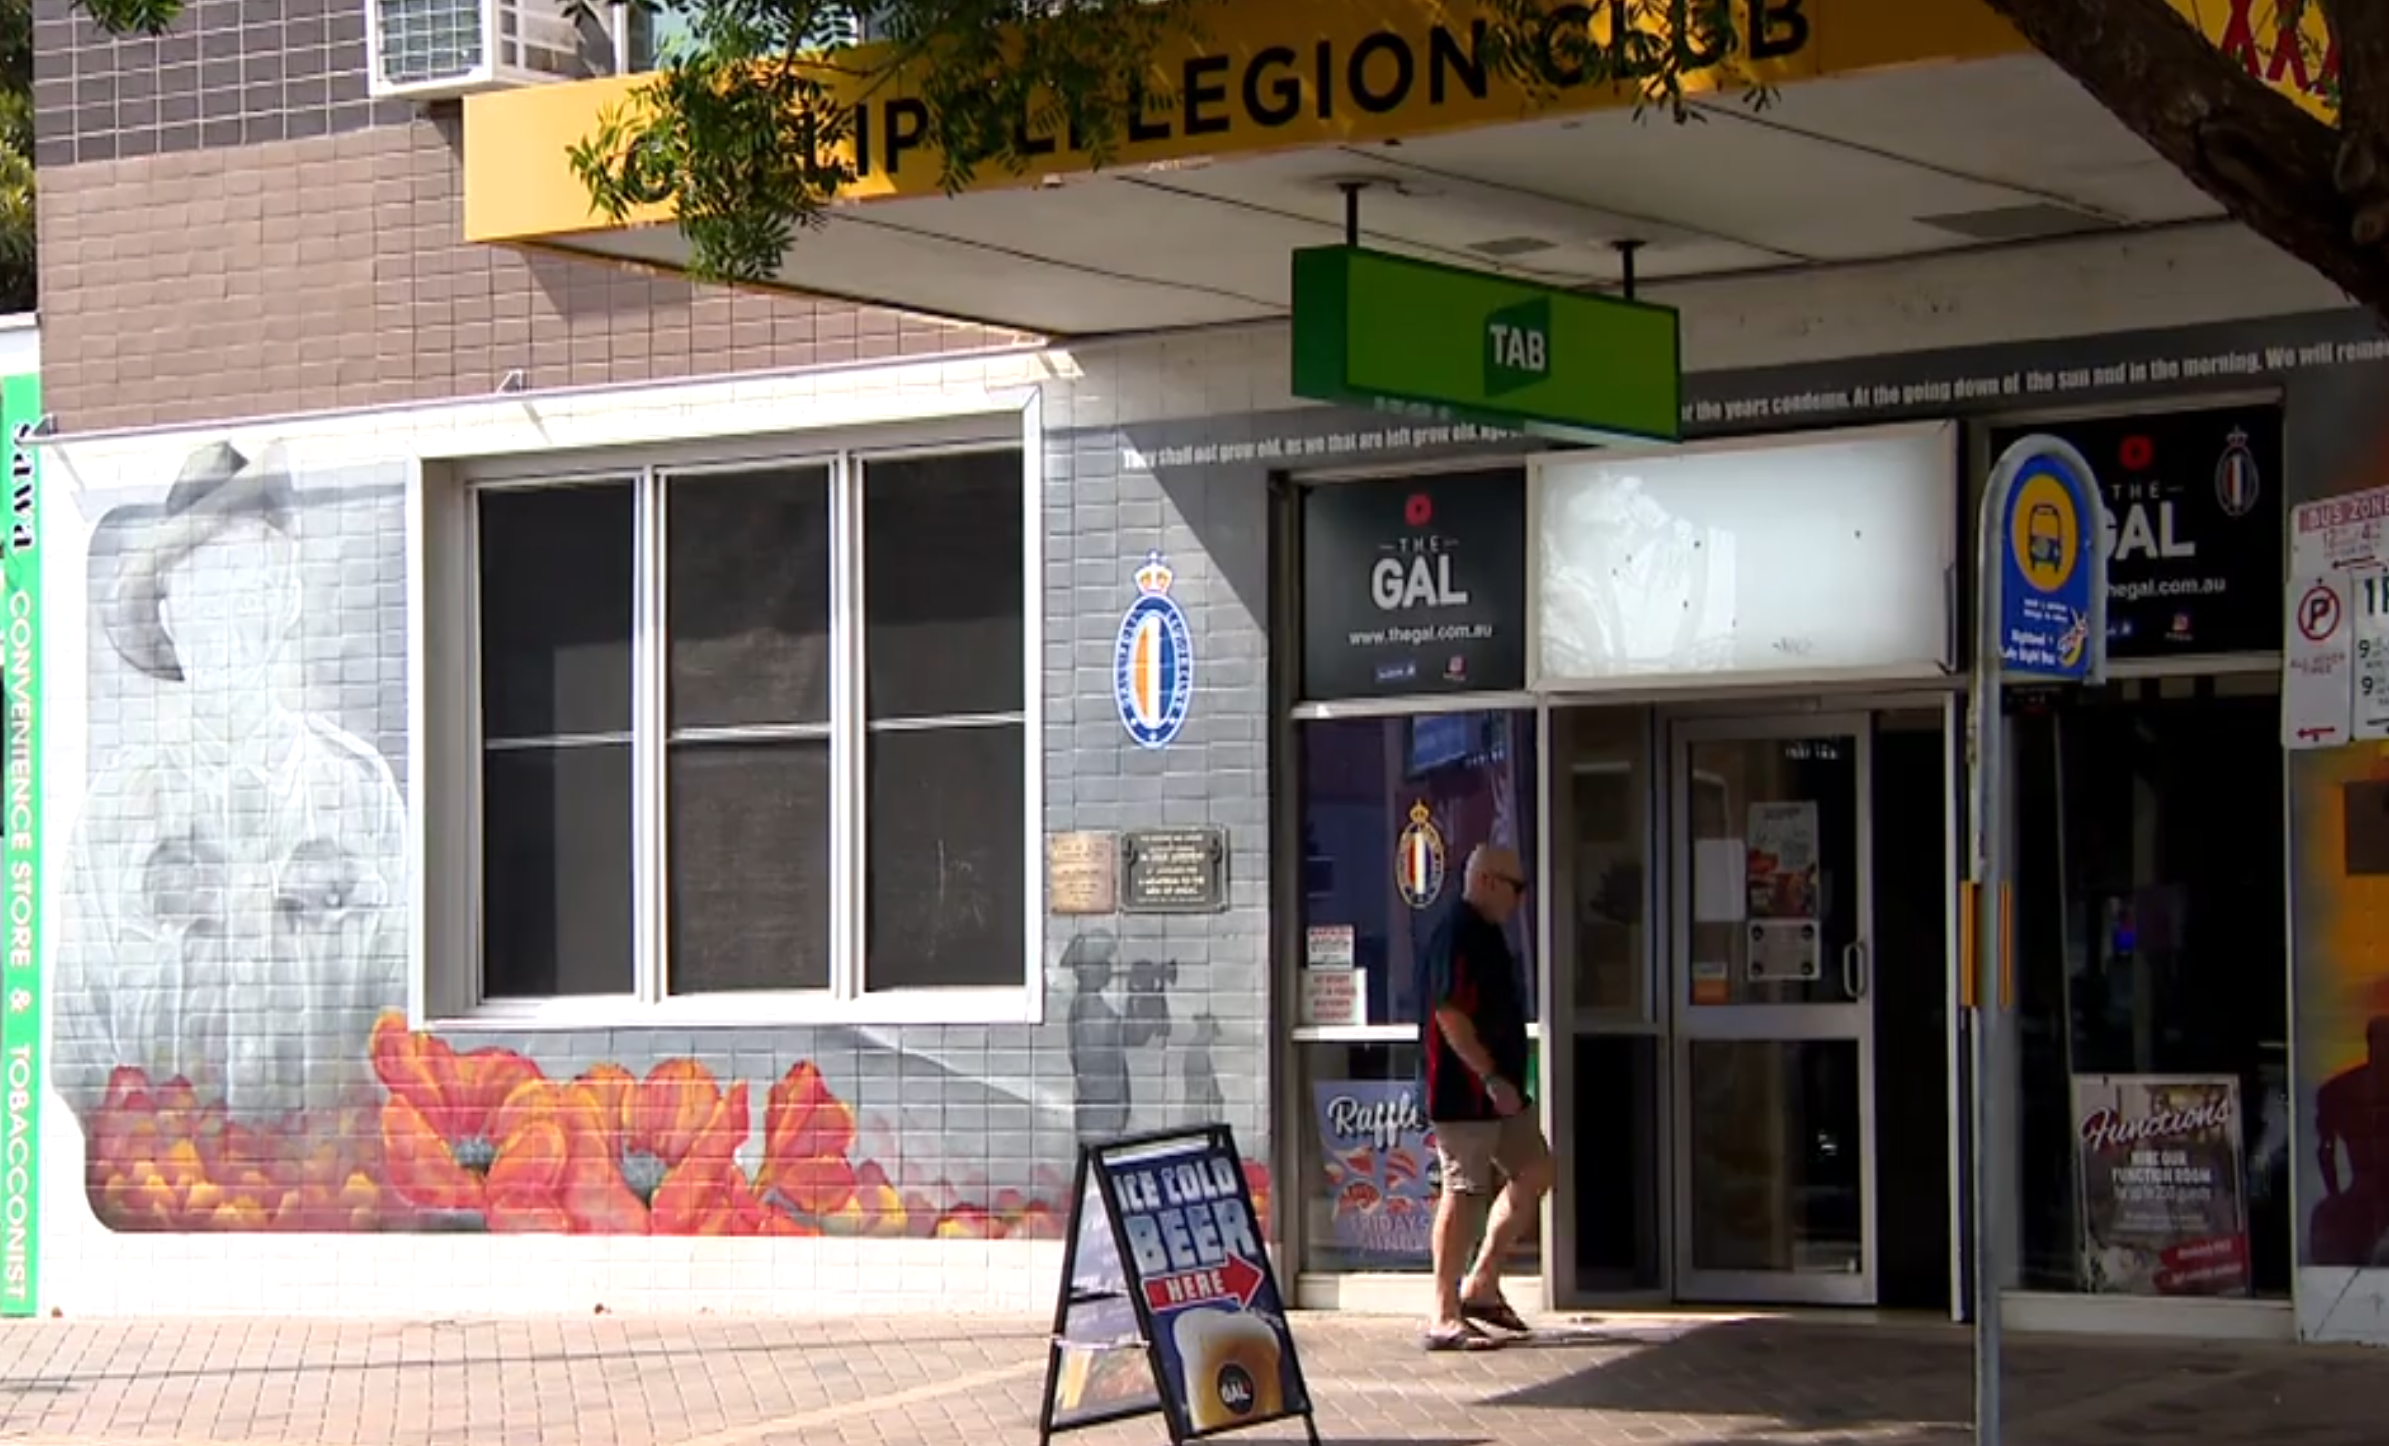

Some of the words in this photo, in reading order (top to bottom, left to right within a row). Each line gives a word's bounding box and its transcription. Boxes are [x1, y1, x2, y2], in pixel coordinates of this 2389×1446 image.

[1128, 19, 1488, 142] LEGION
[1488, 323, 1546, 372] TAB
[1696, 399, 1722, 422] the
[1724, 396, 1769, 420] years
[1852, 385, 1870, 408] At
[1873, 383, 1899, 406] the
[1902, 379, 1951, 405] going
[1954, 375, 2000, 398] down
[2003, 371, 2020, 394] of
[2026, 368, 2053, 392] the
[2058, 367, 2090, 391] sun
[2092, 361, 2126, 385] and
[2129, 361, 2147, 383] in
[2150, 357, 2179, 381] the
[2182, 351, 2264, 377] morning.
[2265, 346, 2296, 369] We
[2298, 341, 2333, 365] will
[2110, 479, 2160, 501] THE
[1399, 535, 1438, 552] THE
[1372, 554, 1468, 610] GAL
[1348, 621, 1493, 646] www.thegal.com.au
[9, 590, 32, 850] CONVENIENCE
[9, 860, 32, 967] STORE
[9, 987, 32, 1013] &
[2080, 1097, 2231, 1152] Functions
[6, 1042, 30, 1303] TOBACCONIST
[1111, 1168, 1161, 1212] ICE
[1160, 1156, 1240, 1203] COLD
[2112, 1166, 2173, 1184] FUNCTION
[1122, 1197, 1258, 1277] BEER
[1165, 1269, 1226, 1303] HERE
